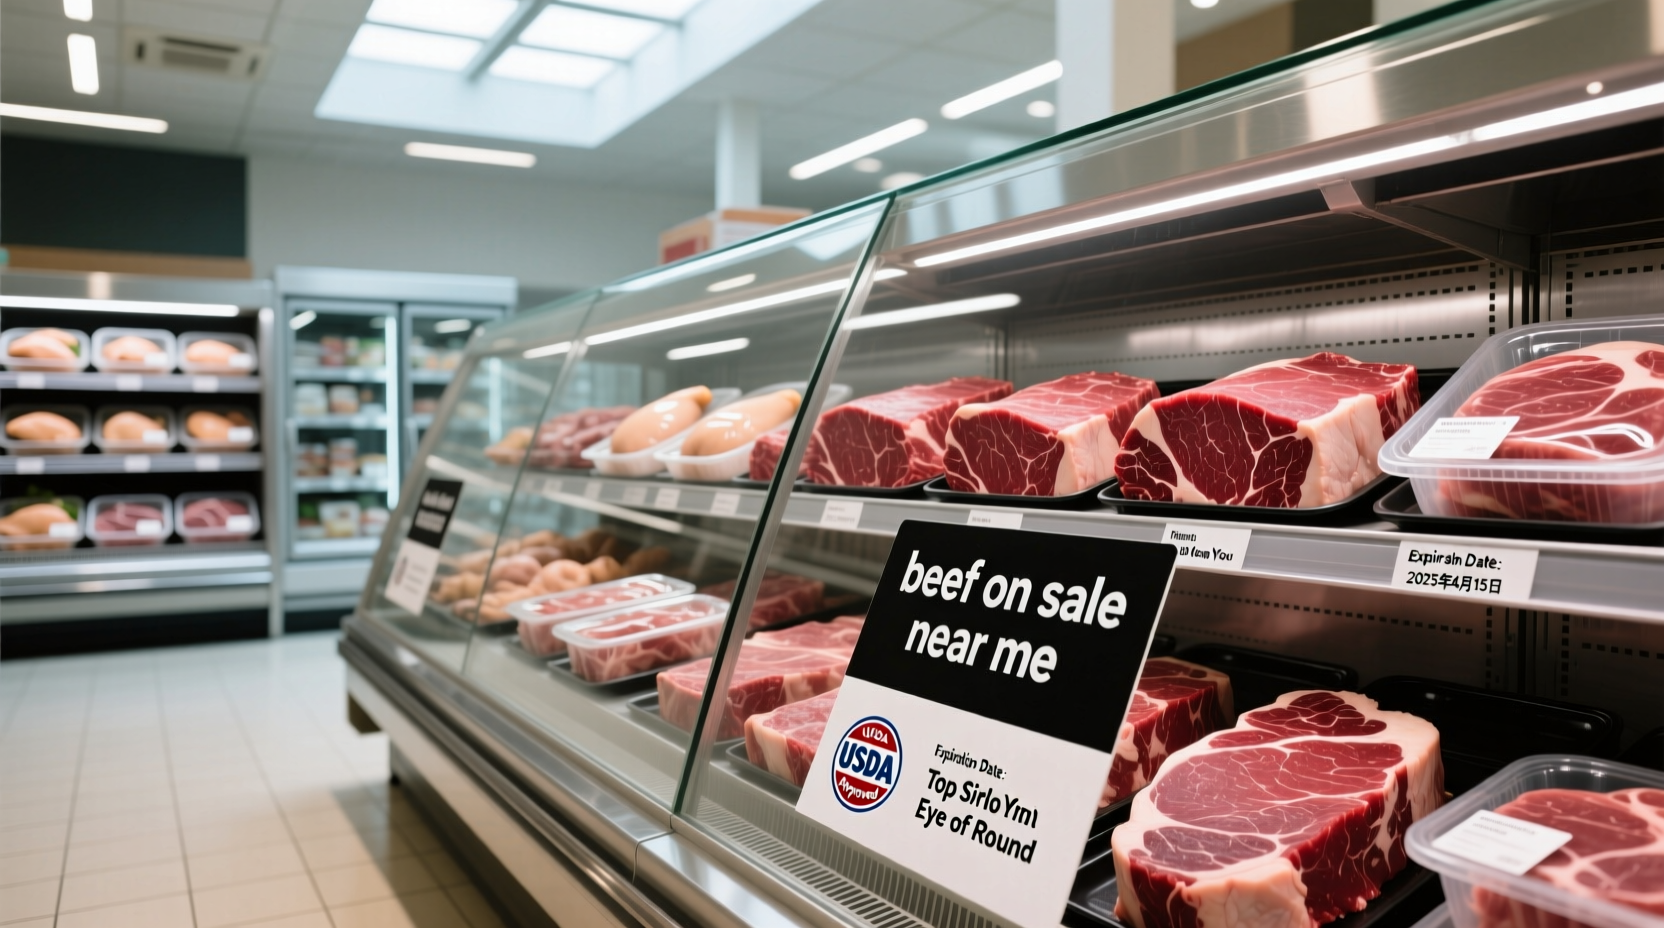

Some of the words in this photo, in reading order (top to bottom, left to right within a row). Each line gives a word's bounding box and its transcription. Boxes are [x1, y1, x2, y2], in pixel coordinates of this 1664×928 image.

[899, 549, 986, 603] beef
[982, 574, 1033, 613] on
[1037, 575, 1128, 629] sale
[904, 619, 990, 667] near
[990, 636, 1058, 684] me
[838, 740, 894, 785] USDA
[927, 768, 958, 802] Top
[915, 797, 948, 828] Eye
[949, 814, 974, 836] of
[971, 819, 1038, 864] Round
